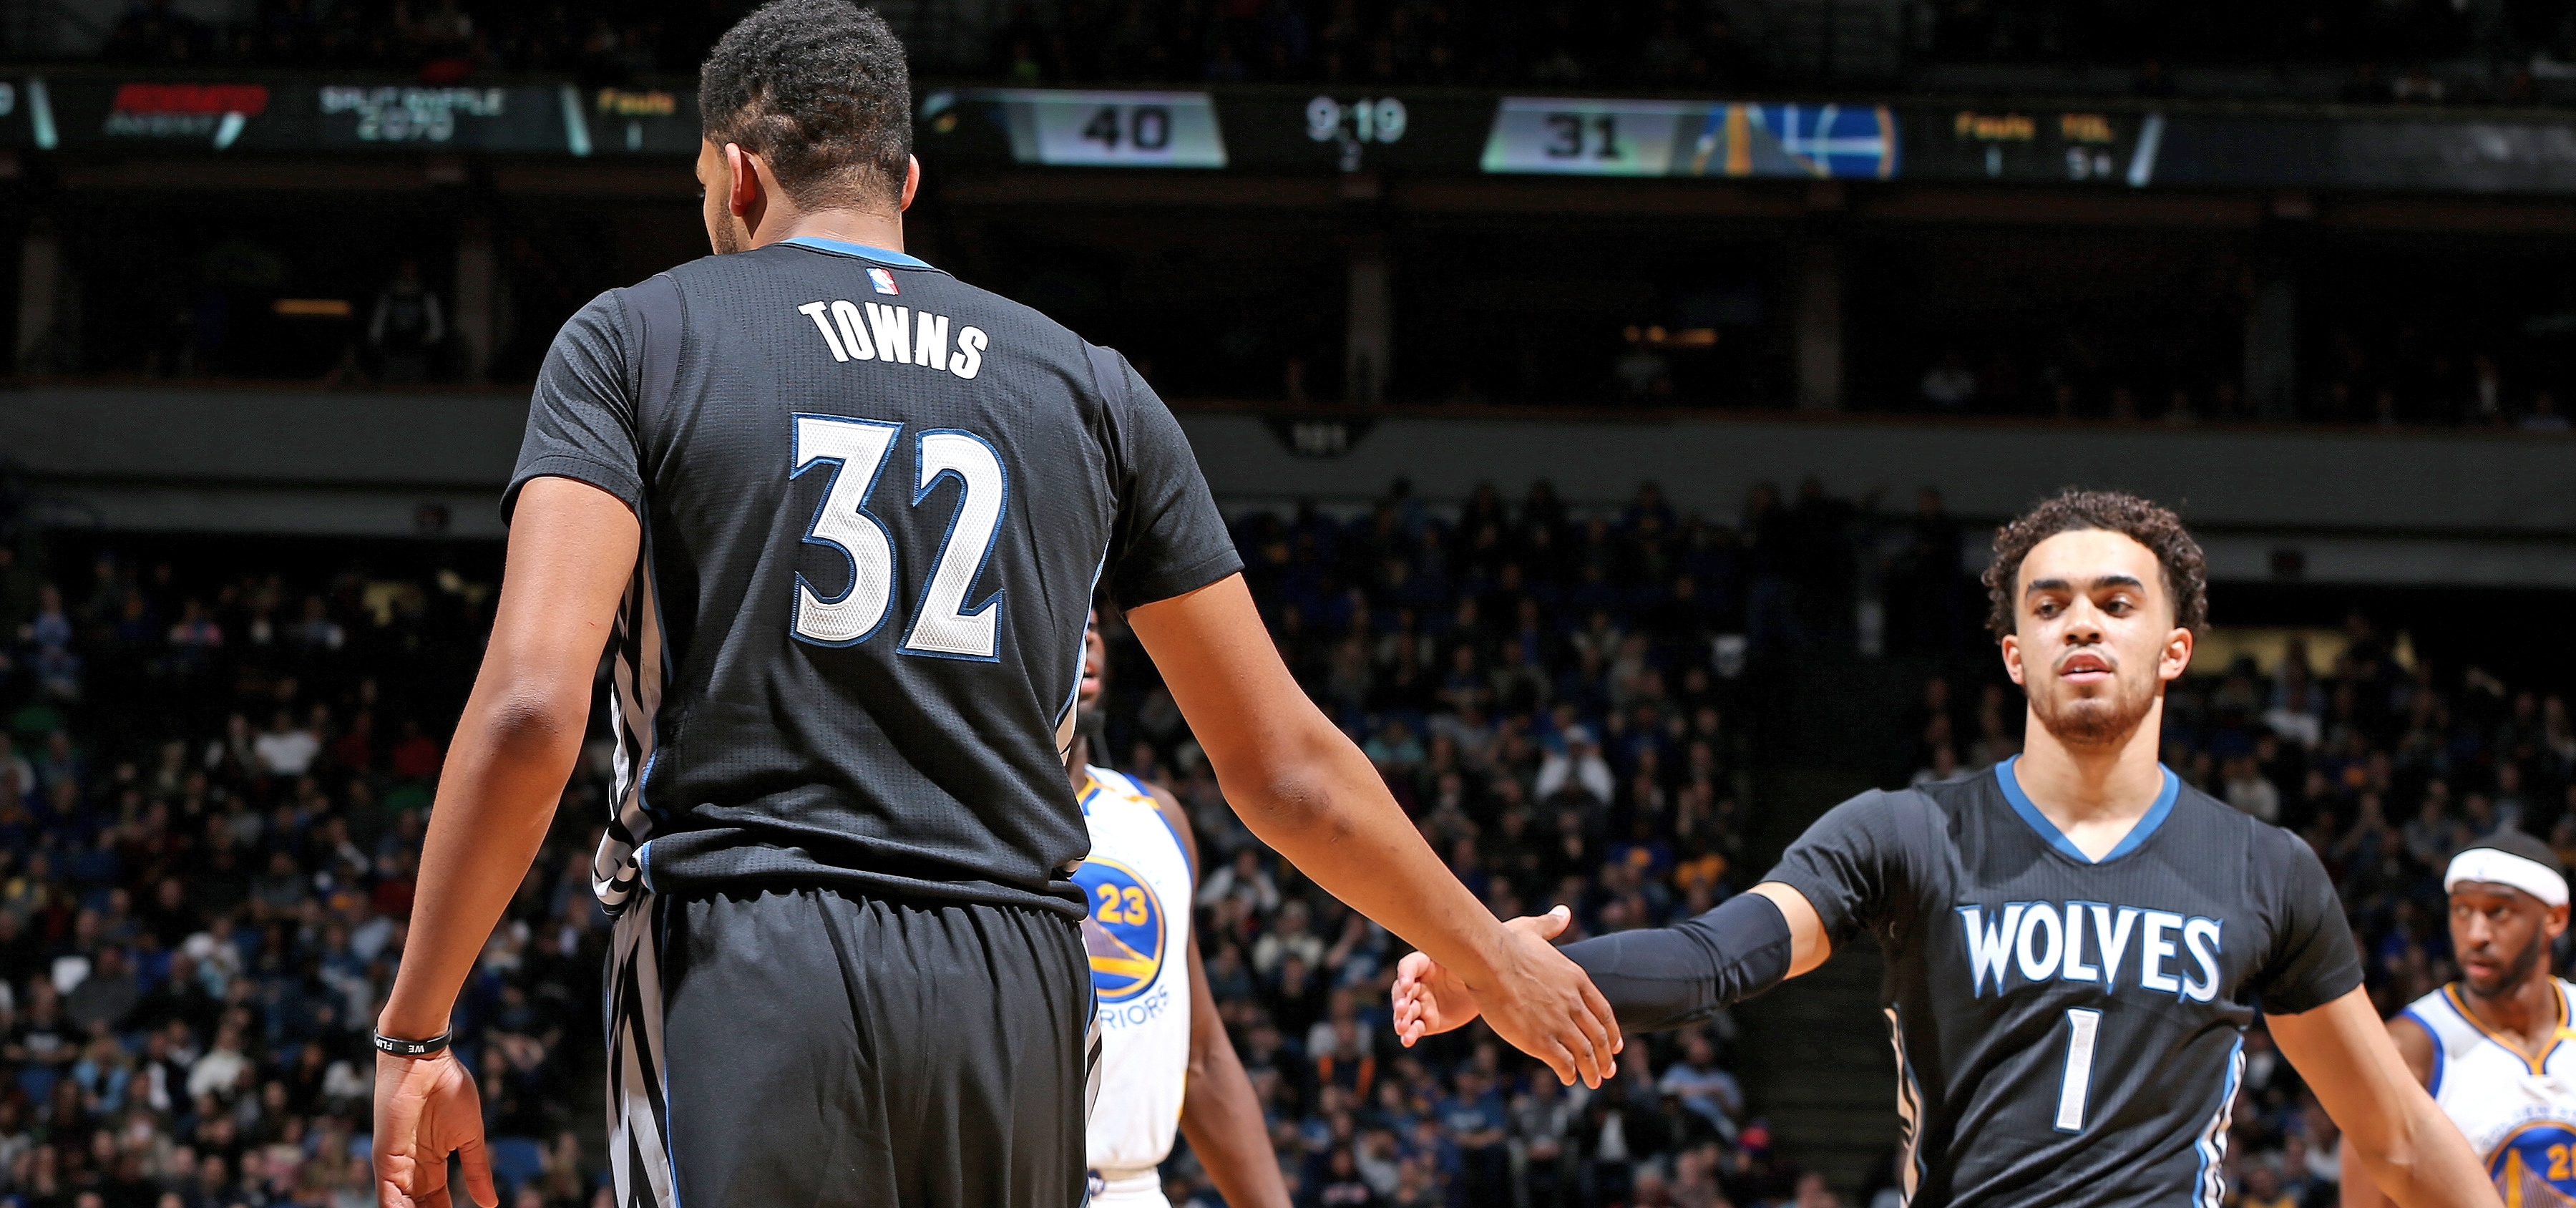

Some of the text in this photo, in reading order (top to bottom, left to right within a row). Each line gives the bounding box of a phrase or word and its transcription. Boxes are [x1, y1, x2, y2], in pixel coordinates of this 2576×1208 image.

[1083, 107, 1172, 151] 40
[1305, 96, 1407, 143] 9:19
[1543, 113, 1623, 159] 31
[796, 298, 990, 381] TOWNS
[789, 411, 1009, 663] 32
[1096, 882, 1149, 927] 23
[1954, 900, 2224, 1003] WOLVES
[1100, 984, 1171, 1029] RIORS
[408, 1044, 425, 1053] WE
[2053, 1006, 2104, 1134] 1
